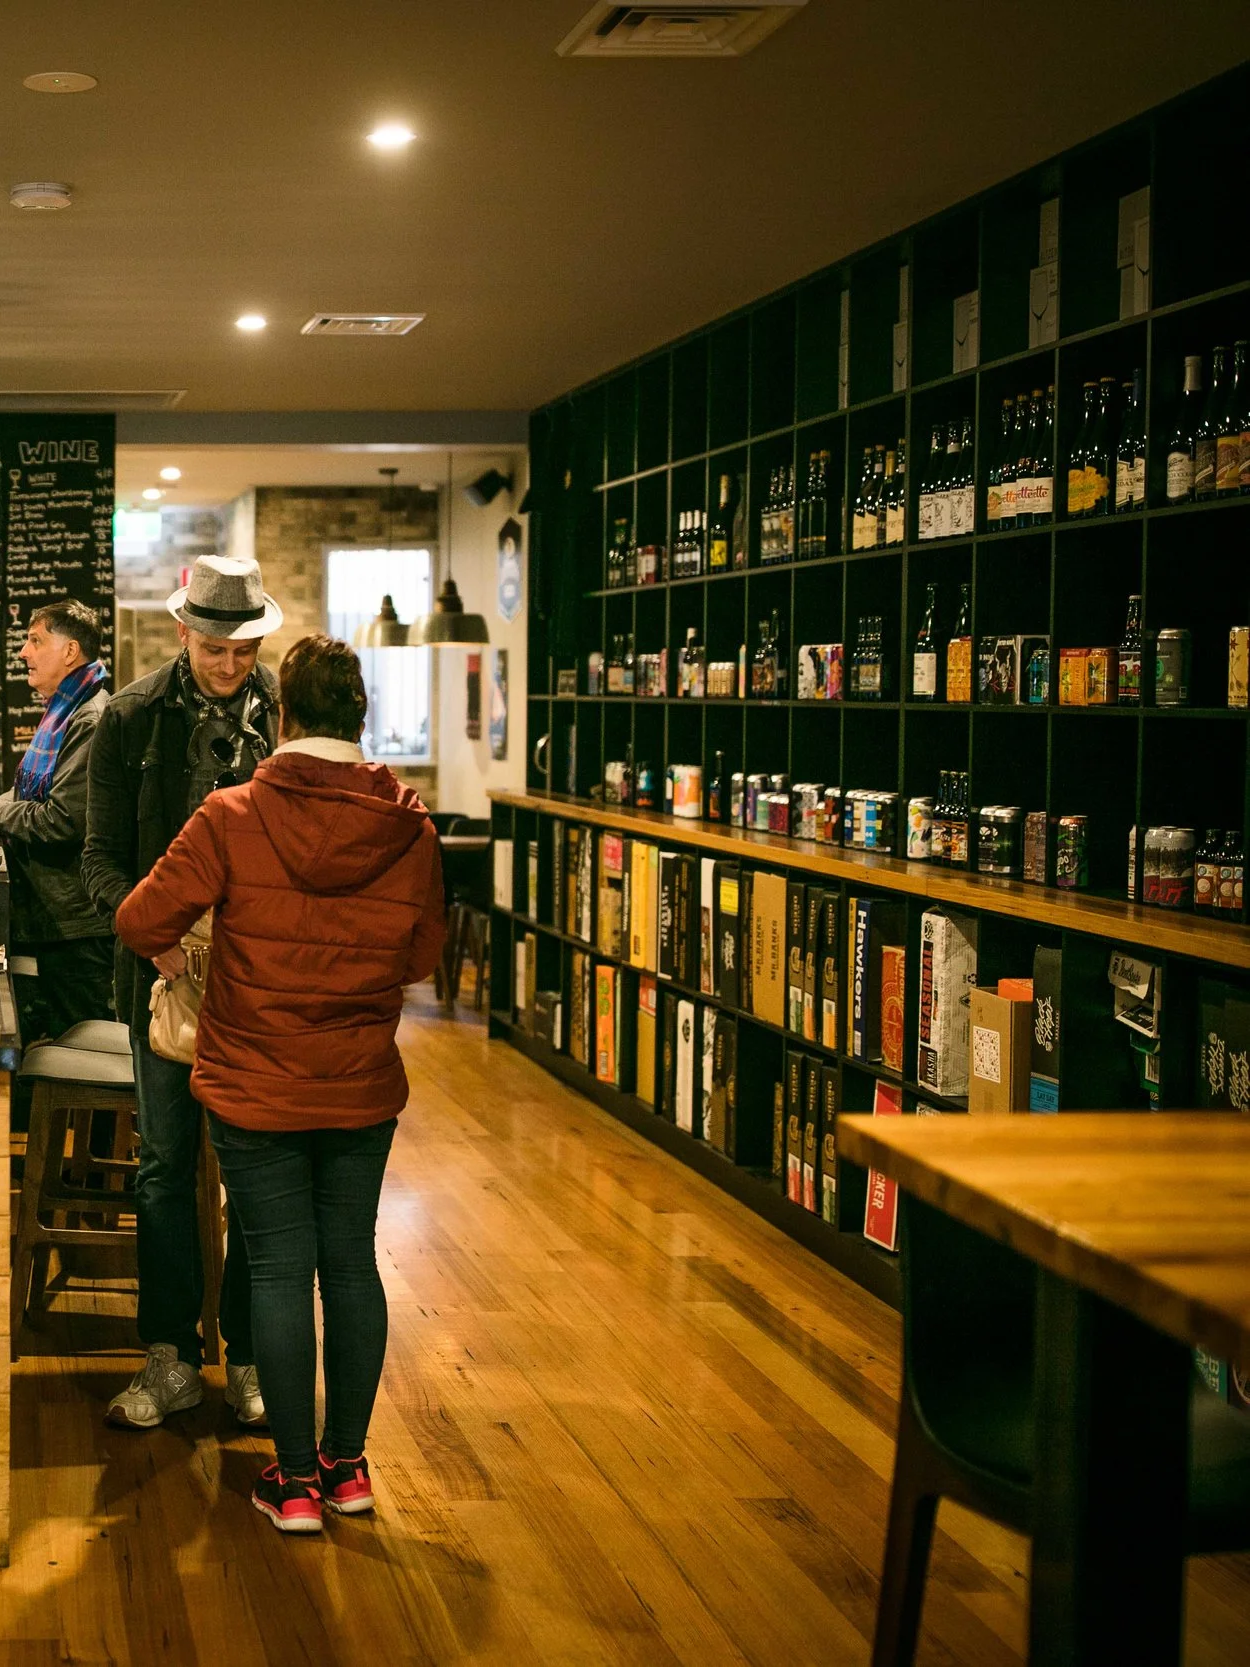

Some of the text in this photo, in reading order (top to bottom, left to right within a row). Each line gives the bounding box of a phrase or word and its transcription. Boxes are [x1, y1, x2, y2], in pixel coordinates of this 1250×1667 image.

[18, 440, 100, 464] WINE
[28, 472, 57, 482] WHITE
[854, 909, 867, 1020] Hawkers
[920, 945, 934, 1040] SEASONAL
[927, 1051, 936, 1084] AKASHA
